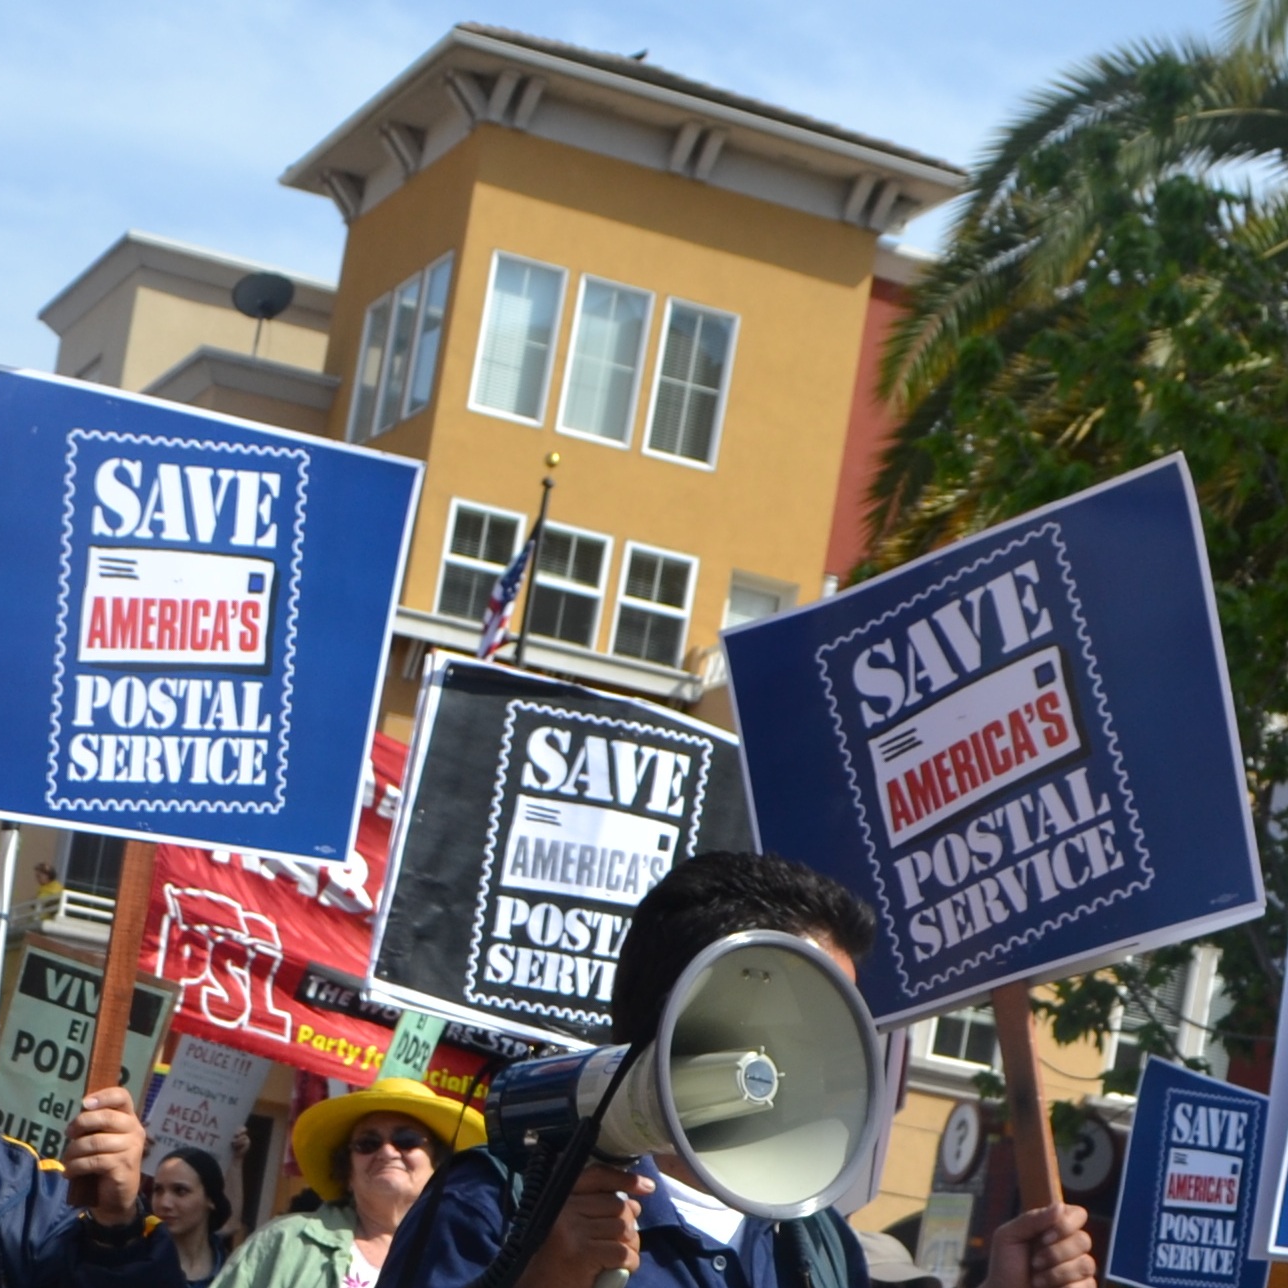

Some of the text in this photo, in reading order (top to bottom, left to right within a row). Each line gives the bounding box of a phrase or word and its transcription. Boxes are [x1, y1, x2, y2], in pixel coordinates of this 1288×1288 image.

[92, 457, 282, 548] SAVE
[86, 596, 261, 653] AMERICA'S
[853, 561, 1053, 727] SAVE
[72, 675, 271, 732] POSTAL
[67, 733, 268, 786] SERVICE
[520, 725, 692, 818] SAVE
[885, 691, 1070, 834] AMERICA'S
[894, 768, 1112, 909] POSTAL
[509, 835, 665, 896] AMERICA'S
[909, 822, 1124, 962] SERVICE
[492, 896, 631, 957] POST
[45, 967, 101, 1014] VIV
[307, 974, 356, 1007] THE
[484, 943, 617, 1001] SERVI
[67, 1019, 89, 1044] El
[297, 1025, 362, 1066] Party
[364, 1044, 386, 1070] fo
[11, 1029, 130, 1088] POD
[186, 1043, 231, 1073] POLICE
[38, 1092, 74, 1122] del
[167, 1103, 218, 1129] MEDIA
[198, 1101, 209, 1111] A
[1172, 1103, 1249, 1152] SAVE
[161, 1118, 220, 1147] EVENT
[1167, 1171, 1237, 1205] AMERICA'S
[1160, 1211, 1238, 1248] POSTAL
[1156, 1243, 1236, 1277] SERVICE
